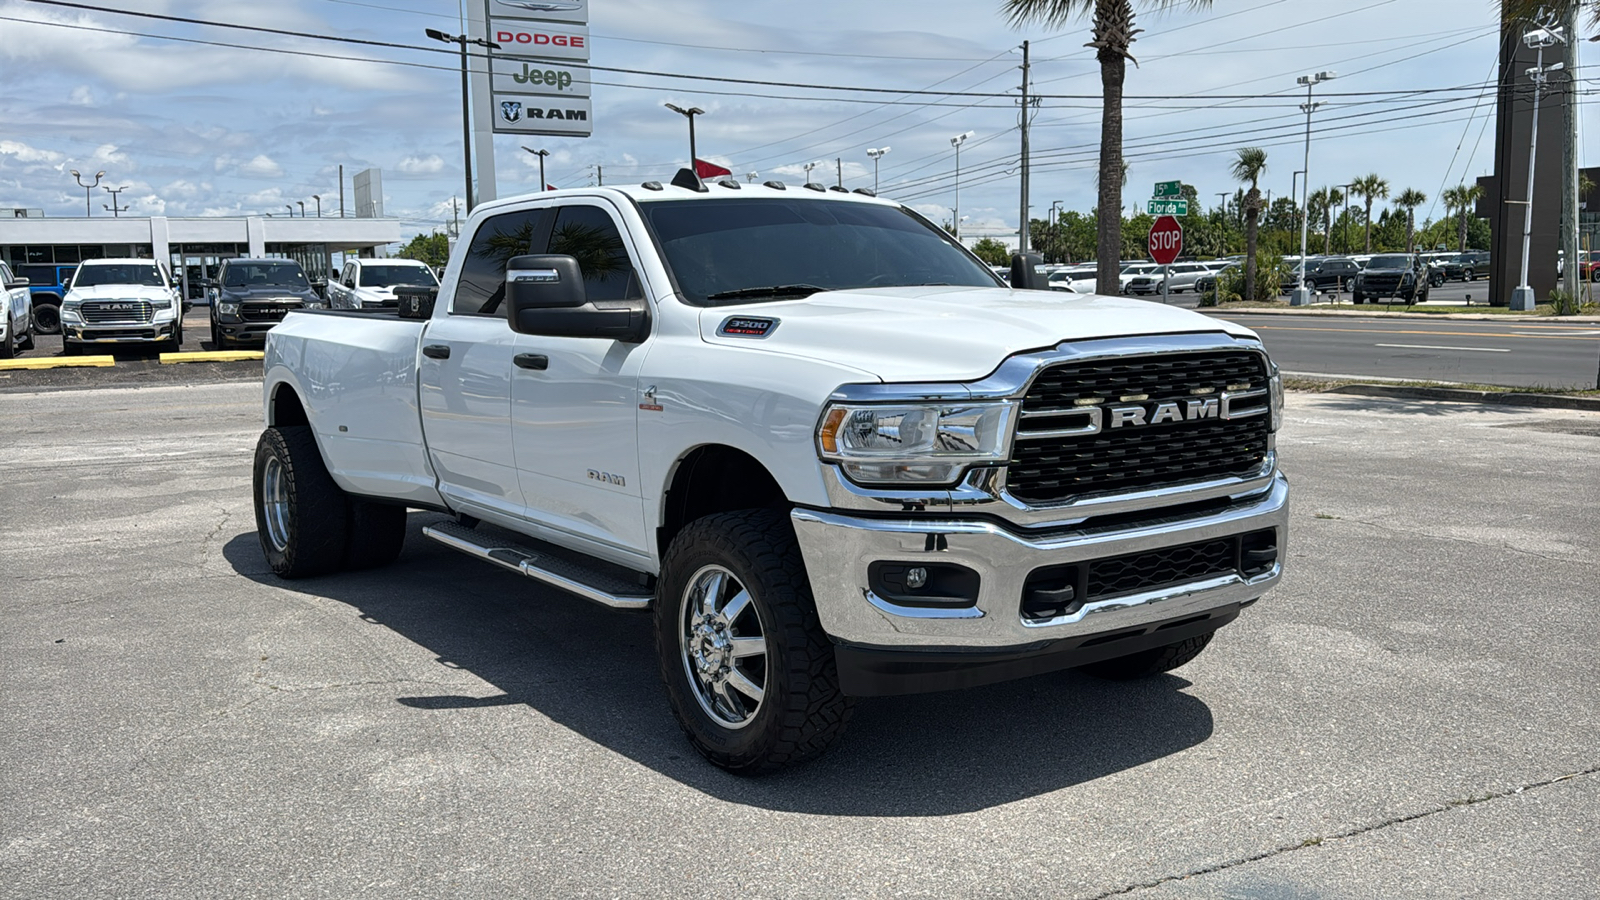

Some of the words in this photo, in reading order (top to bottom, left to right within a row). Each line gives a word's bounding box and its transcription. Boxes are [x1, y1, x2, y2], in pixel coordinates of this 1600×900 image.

[497, 31, 584, 48] DODGE
[513, 63, 572, 90] Jeep
[527, 107, 587, 121] RAM
[1148, 201, 1176, 213] Florida
[1151, 230, 1180, 251] STOP
[730, 320, 768, 329] 3500
[1110, 397, 1218, 428] RAM
[586, 468, 626, 487] RAM
